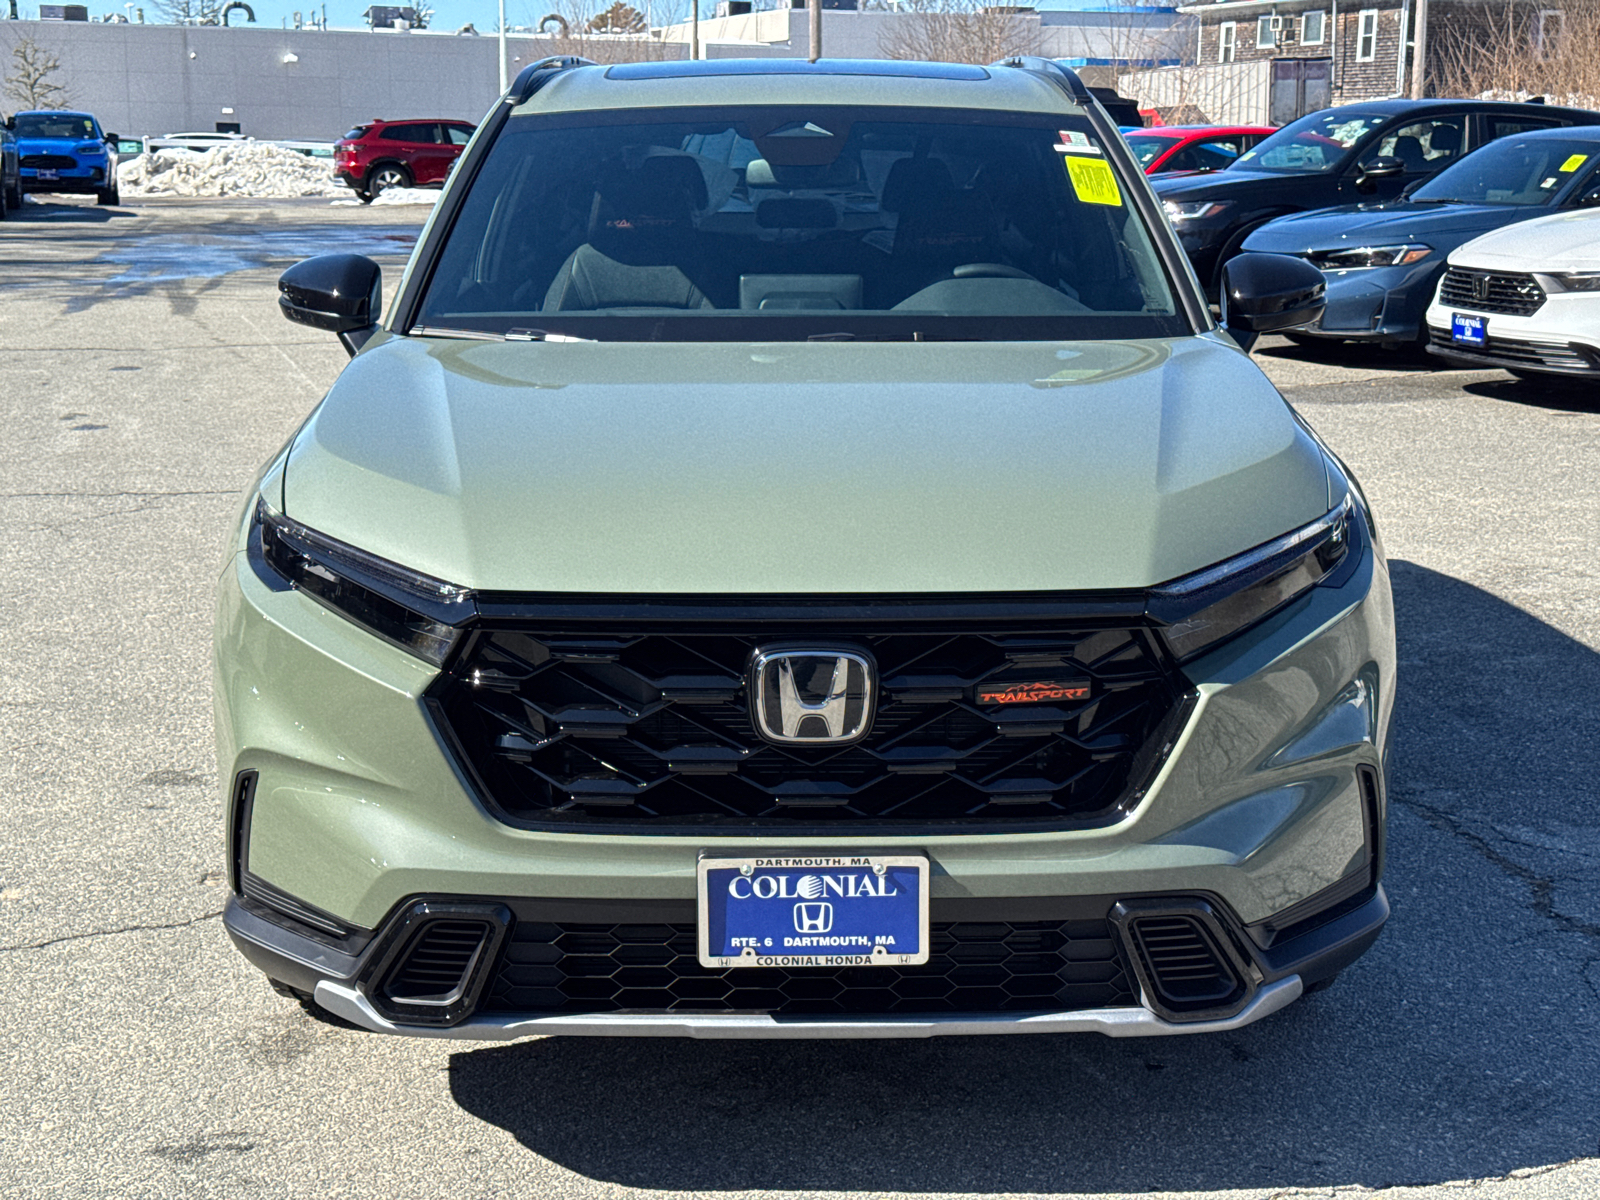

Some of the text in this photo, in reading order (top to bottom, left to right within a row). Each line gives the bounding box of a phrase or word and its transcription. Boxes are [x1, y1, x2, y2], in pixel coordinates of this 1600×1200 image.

[980, 687, 1088, 703] TRAILSPORT
[851, 857, 871, 866] MA
[728, 874, 897, 899] COLONIAL
[731, 935, 896, 947] RTE. 6 DARTMOUTH, MA
[756, 955, 873, 966] COLONIAL HONDA
